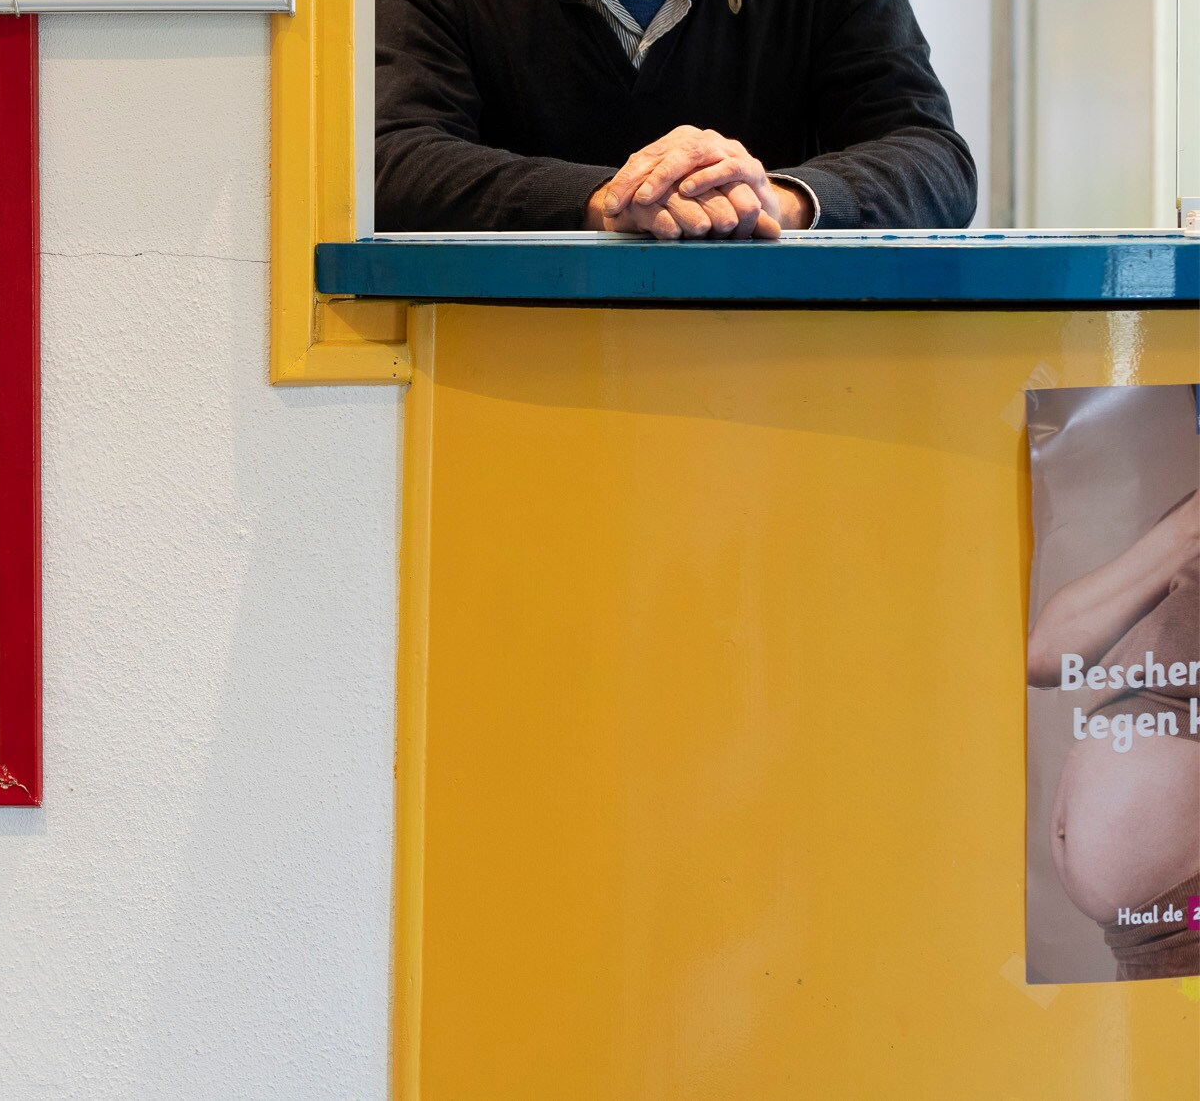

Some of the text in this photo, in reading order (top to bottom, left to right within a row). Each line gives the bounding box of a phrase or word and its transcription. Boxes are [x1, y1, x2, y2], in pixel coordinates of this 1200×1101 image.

[1073, 707, 1179, 753] tegen
[1118, 904, 1183, 925] Haal de
